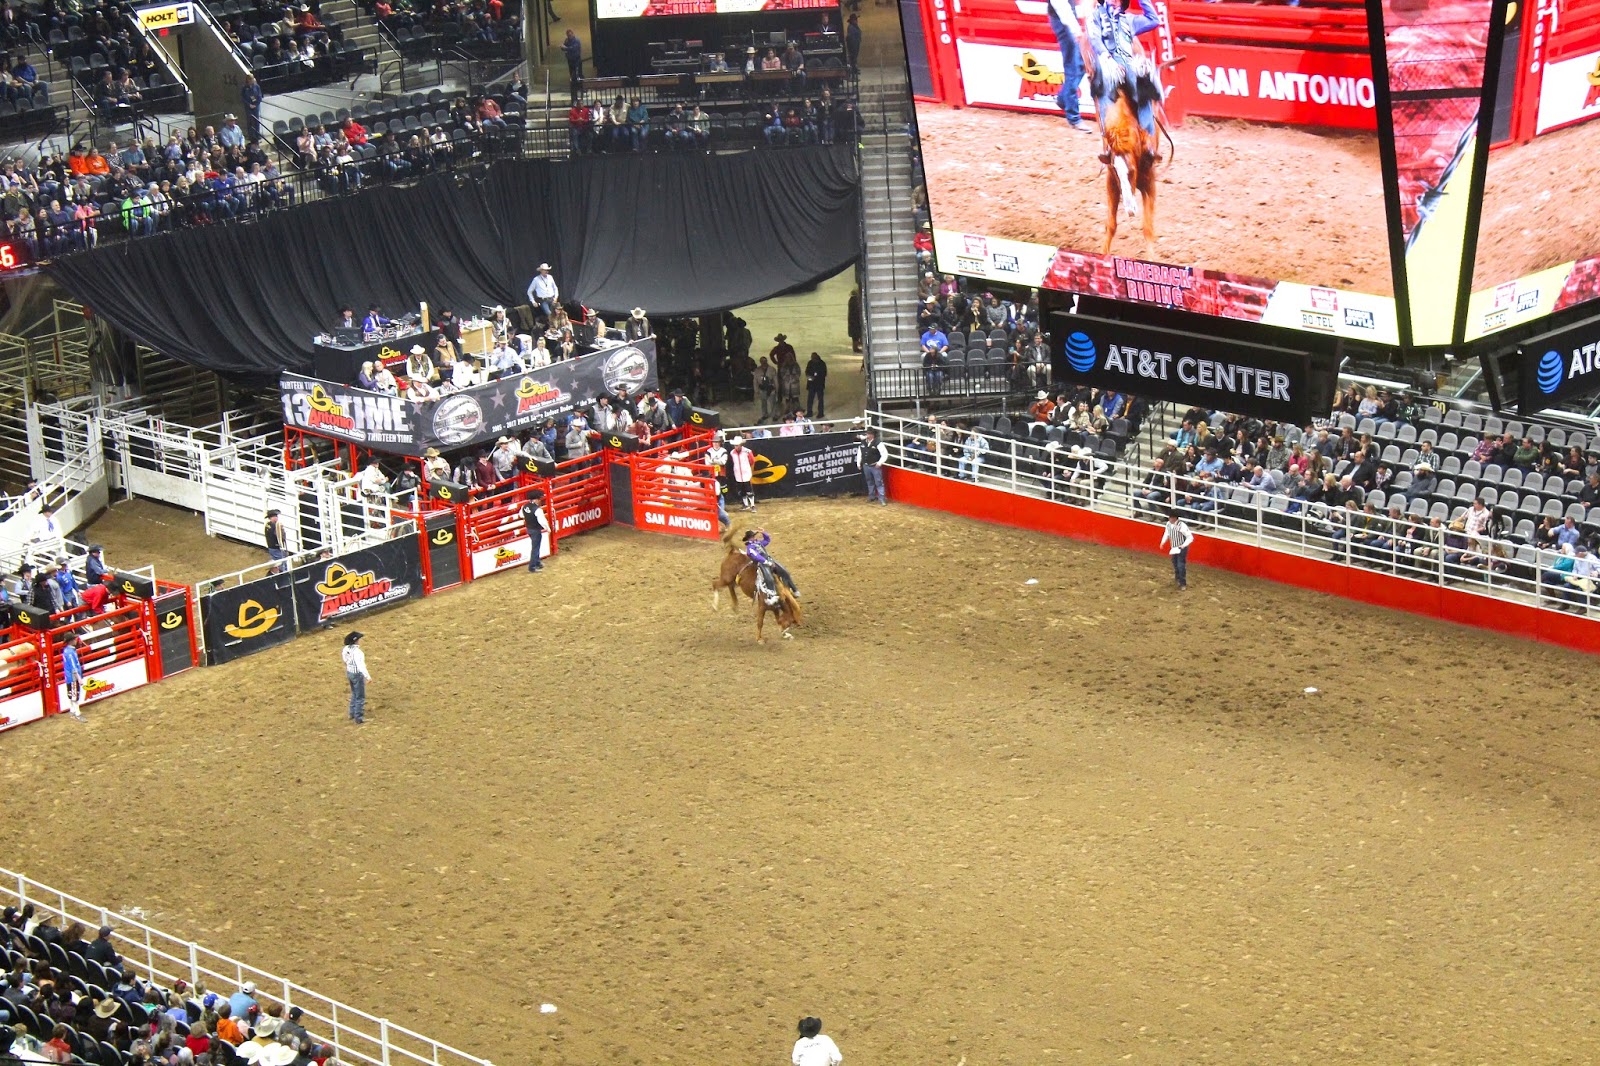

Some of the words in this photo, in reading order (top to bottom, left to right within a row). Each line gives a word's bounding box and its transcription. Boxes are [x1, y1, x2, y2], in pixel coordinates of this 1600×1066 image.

[146, 12, 174, 23] HOLT
[1196, 65, 1249, 97] SAN
[1258, 70, 1376, 108] ANTONIO
[1115, 258, 1191, 288] BAREBACK
[1126, 279, 1184, 306] RIDING
[1104, 344, 1171, 380] AT&T
[1177, 356, 1290, 401] CENTER
[306, 384, 343, 415] San
[335, 394, 409, 431] TIME
[308, 408, 354, 430] Antonio
[368, 433, 396, 442] THIRTEEN
[397, 434, 413, 443] TIME
[795, 463, 824, 475] STOCK
[825, 456, 852, 468] SHOW
[797, 456, 816, 466] SAN
[817, 447, 858, 462] ANTONIO
[813, 466, 844, 478] RODEO
[562, 507, 601, 528] ANTONIO
[644, 511, 665, 525] SAN
[668, 516, 712, 532] ANTONIO
[316, 563, 374, 597] San
[321, 580, 391, 620] Antonio
[338, 602, 359, 613] Stock
[359, 597, 378, 607] Show
[384, 587, 406, 599] Rodeo
